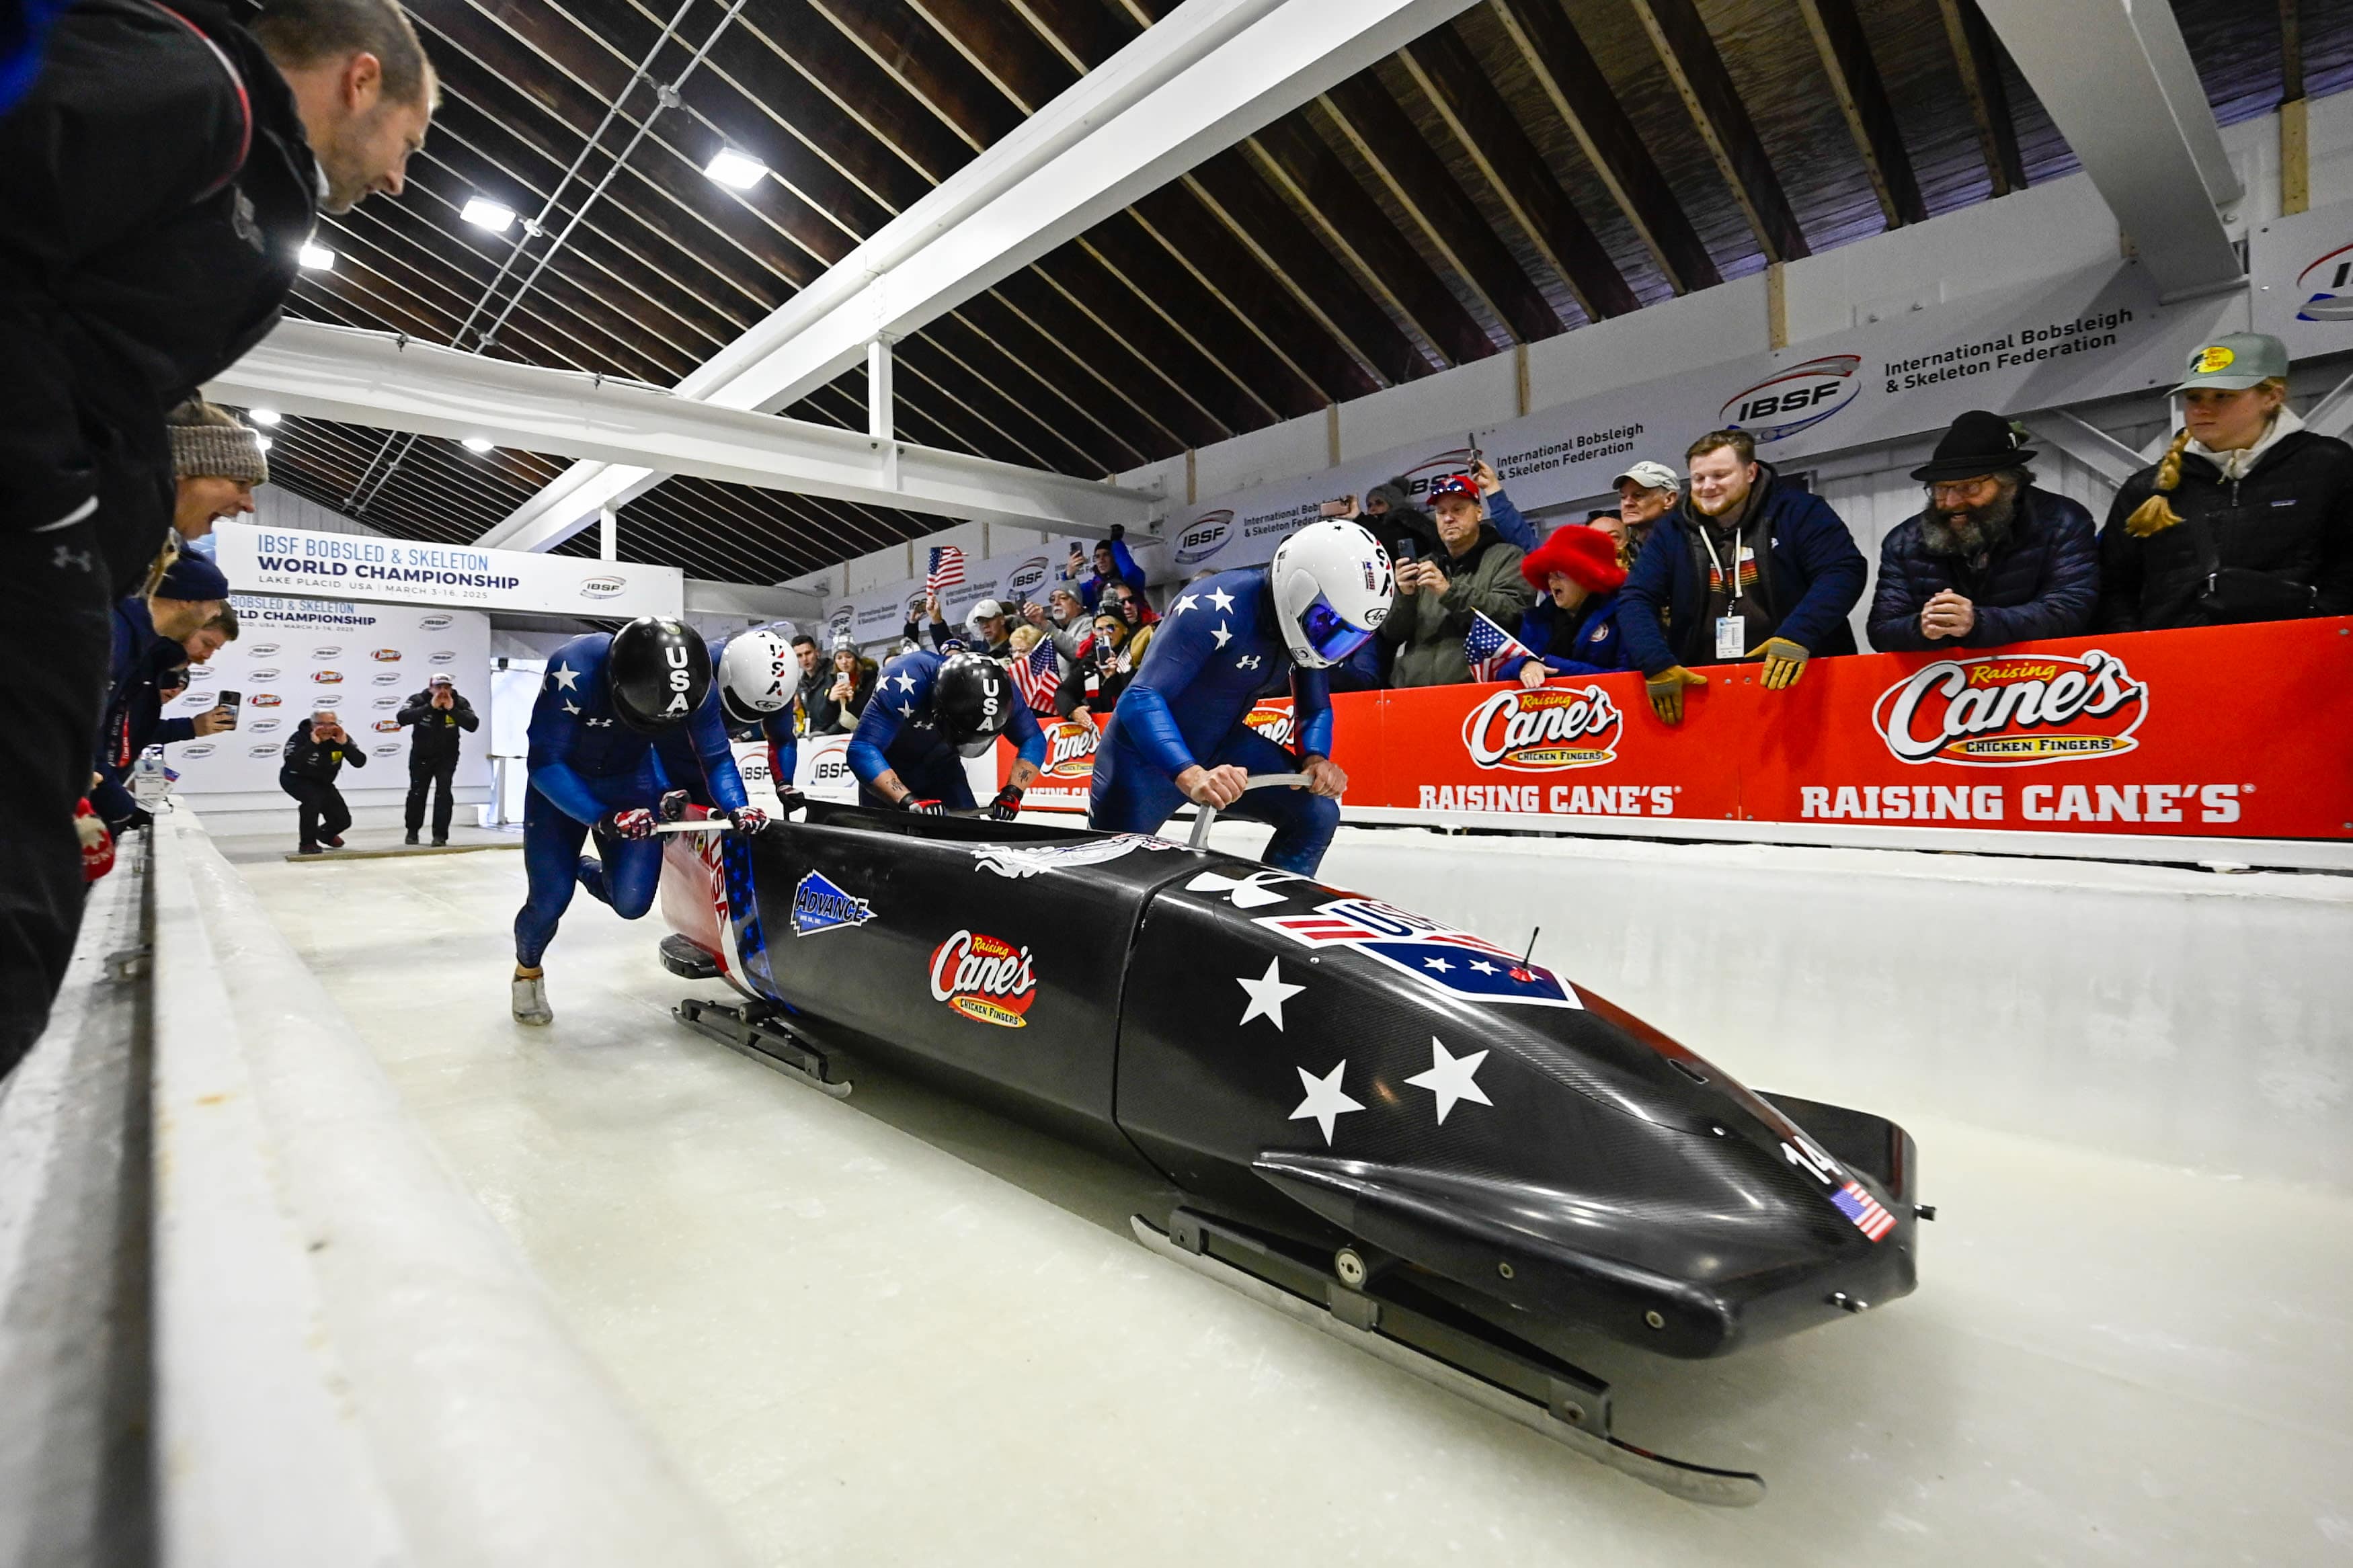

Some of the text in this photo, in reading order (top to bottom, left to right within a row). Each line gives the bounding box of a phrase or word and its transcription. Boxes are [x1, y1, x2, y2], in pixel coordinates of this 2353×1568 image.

[1886, 308, 2133, 376] International Bobsleigh
[1886, 334, 2116, 393] & Skeleton Federation
[1738, 381, 1841, 421] IBSF
[1497, 423, 1644, 468] International Bobsleigh
[1497, 441, 1634, 481] & Skeleton Federation
[1244, 507, 1299, 526] International
[1244, 529, 1250, 538] &
[1252, 522, 1290, 537] Skeleton
[257, 534, 488, 571] IBSF BOBSLED & SKELETON
[1183, 526, 1225, 548] IBSF
[257, 556, 519, 589] WORLD CHAMPIONSHIP
[258, 575, 291, 585] LAKE
[350, 582, 372, 591] USA
[385, 585, 426, 595] MARCH
[463, 590, 488, 600] 2025
[587, 583, 620, 591] IBSF
[1012, 571, 1043, 587] IBSF
[231, 595, 284, 610] BOBSLED
[299, 601, 354, 614] SKELETON
[264, 611, 376, 626] CHAMPIONSHIP
[665, 646, 690, 712] USA
[765, 644, 785, 696] USA
[1970, 663, 2057, 684] Raising
[976, 678, 1000, 731] USA
[1520, 693, 1572, 708] Raising
[1887, 654, 2141, 757] Cane's
[1471, 688, 1617, 764] Cane's
[1966, 739, 2112, 753] CHICKEN FINGERS
[1419, 785, 1540, 812] RAISING
[1800, 786, 2003, 820] RAISING
[709, 835, 729, 921] USA
[796, 886, 868, 924] ADVANCE
[930, 929, 1037, 1001] Cane's
[971, 936, 1009, 960] Raising
[960, 998, 1019, 1025] CHICKEN FINGERS
[1780, 1134, 1843, 1185] 14
